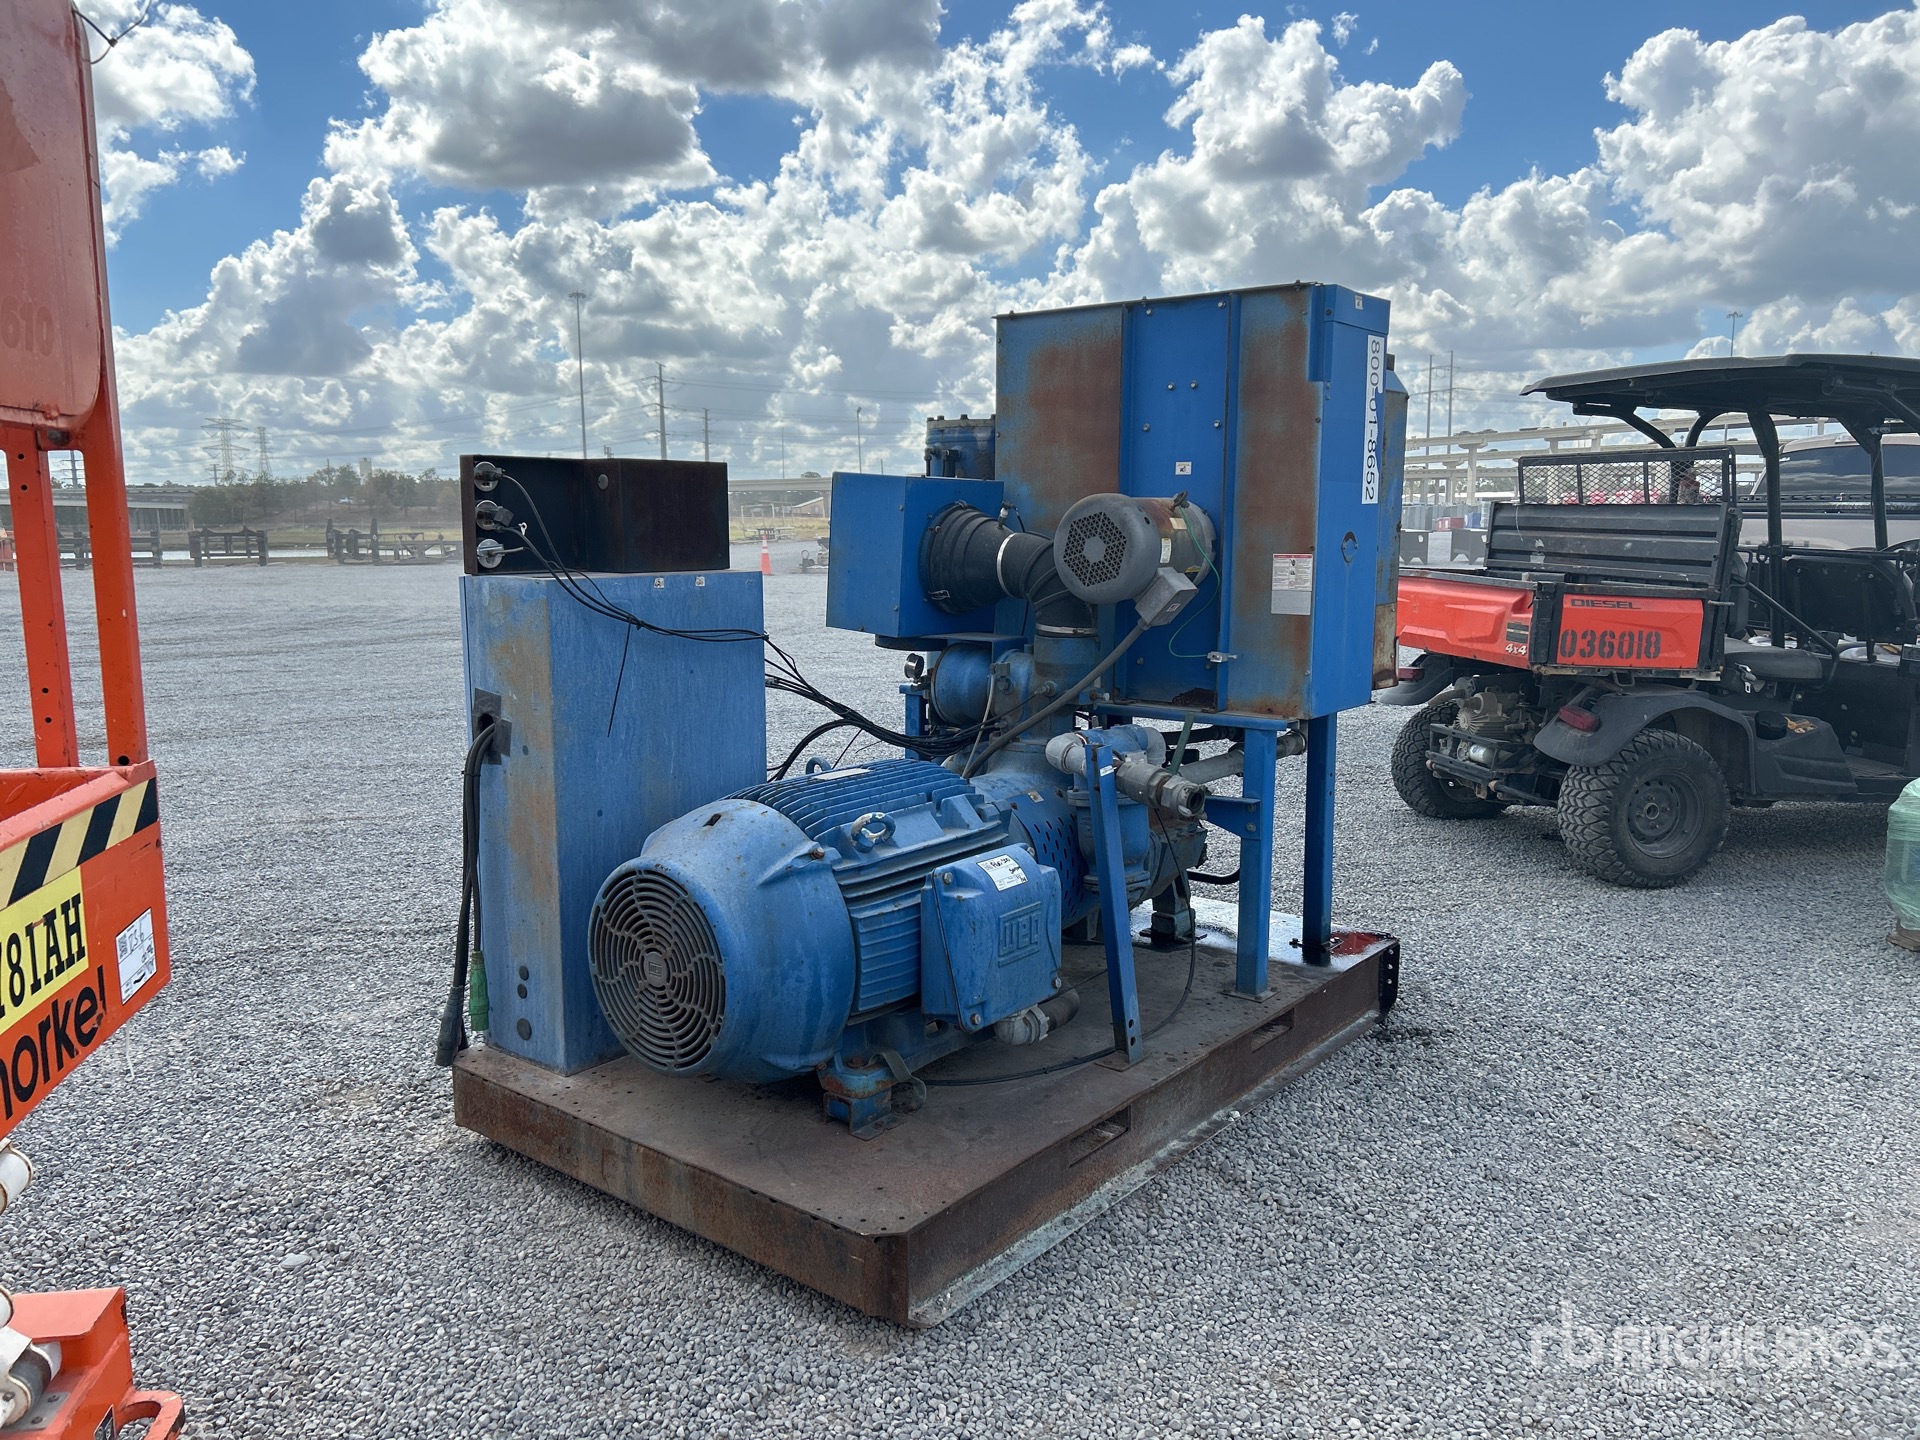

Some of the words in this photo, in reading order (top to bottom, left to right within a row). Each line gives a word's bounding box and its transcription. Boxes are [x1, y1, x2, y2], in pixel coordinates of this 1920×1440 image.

[1570, 598, 1642, 610] DIESEL
[1505, 643, 1528, 656] 4x4
[1560, 629, 1662, 660] 036018
